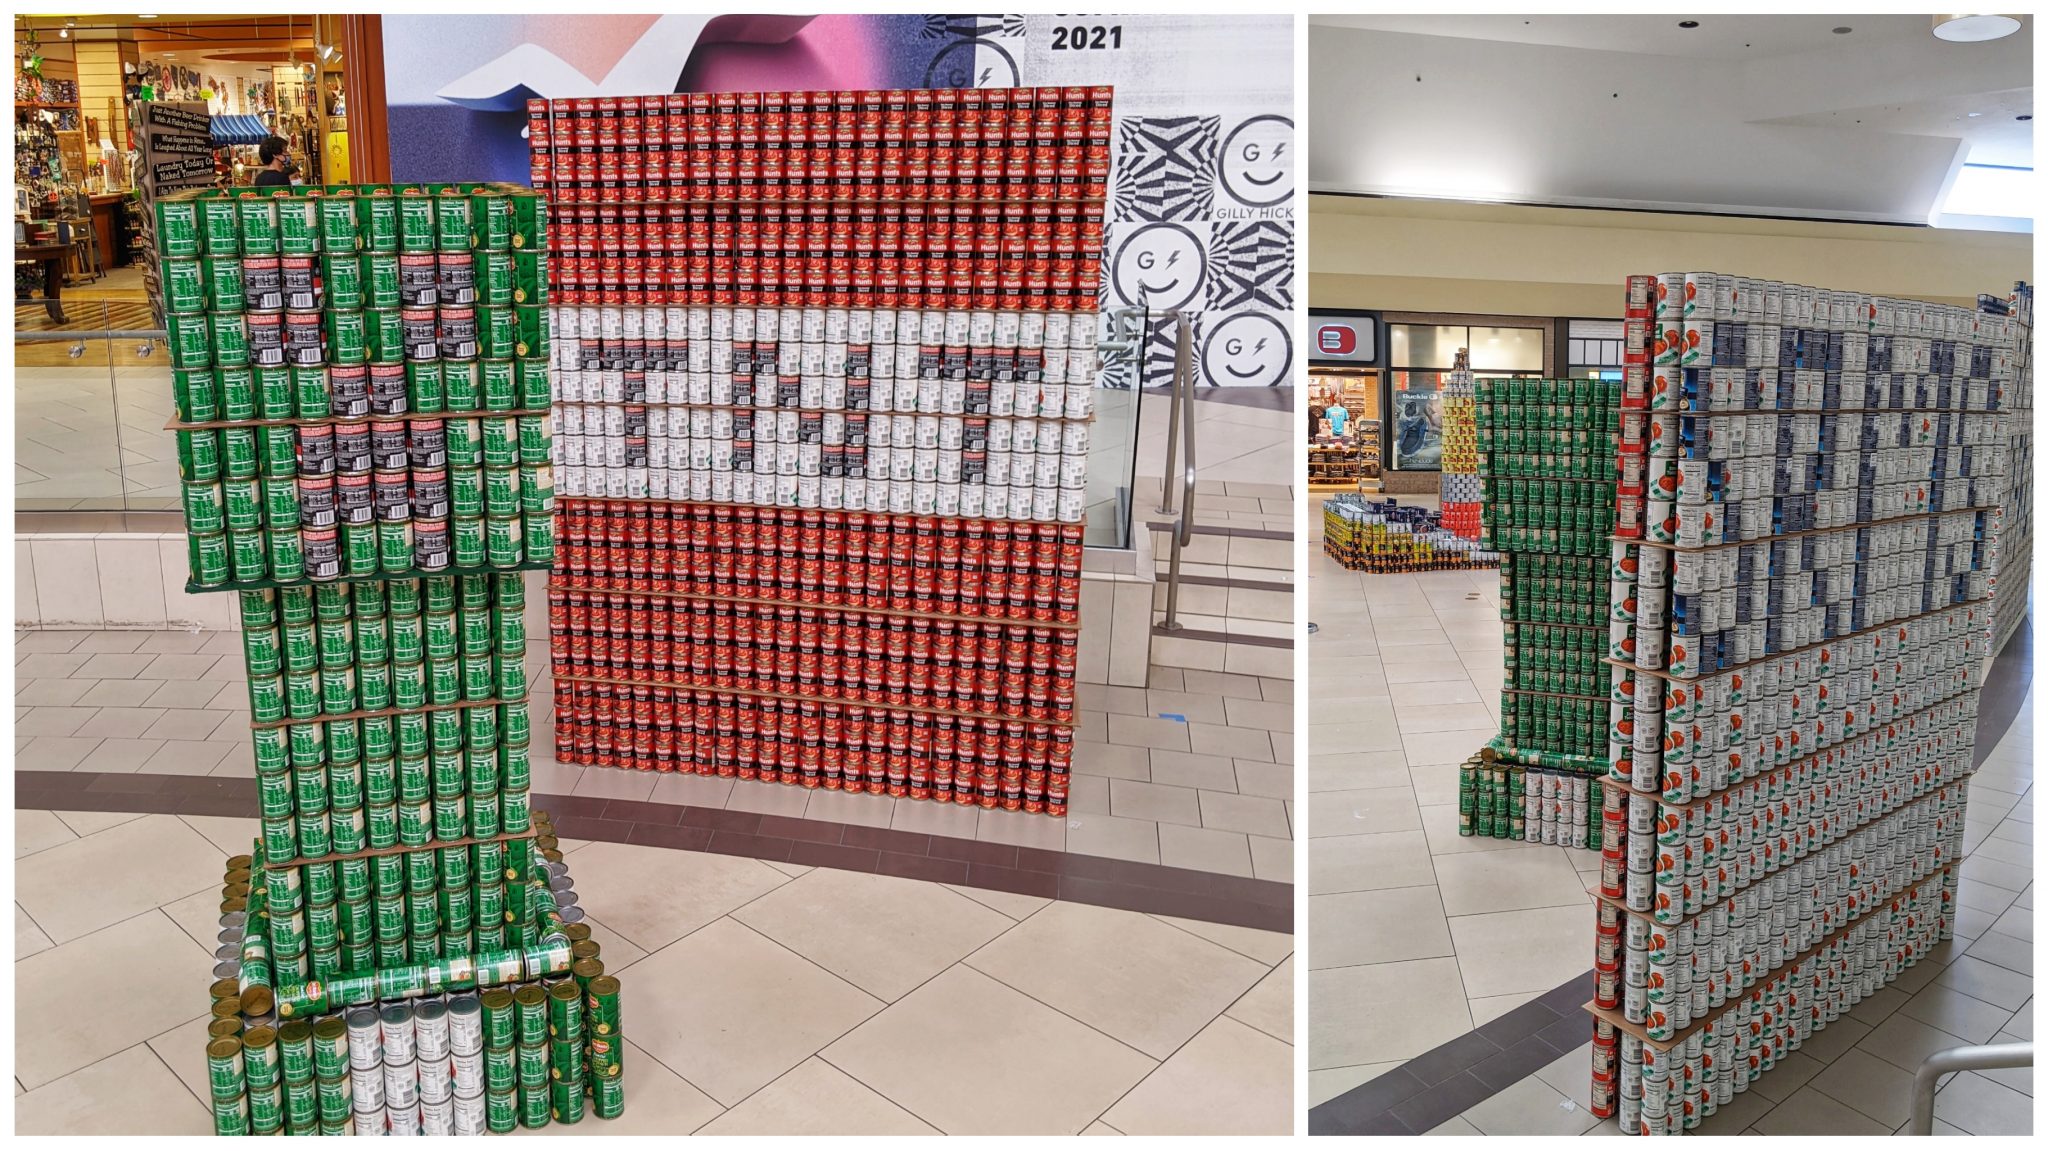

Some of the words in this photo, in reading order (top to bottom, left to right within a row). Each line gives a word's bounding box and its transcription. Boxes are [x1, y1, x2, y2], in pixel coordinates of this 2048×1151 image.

[1051, 25, 1122, 50] 2021
[1243, 143, 1260, 162] G
[156, 161, 184, 172] Laundry
[184, 158, 205, 169] Today
[160, 170, 181, 181] Naked
[182, 168, 214, 178] Tomorrow
[1216, 207, 1255, 219] GILLY
[1260, 207, 1294, 219] HICK
[1137, 251, 1155, 270] G
[1225, 338, 1243, 356] G
